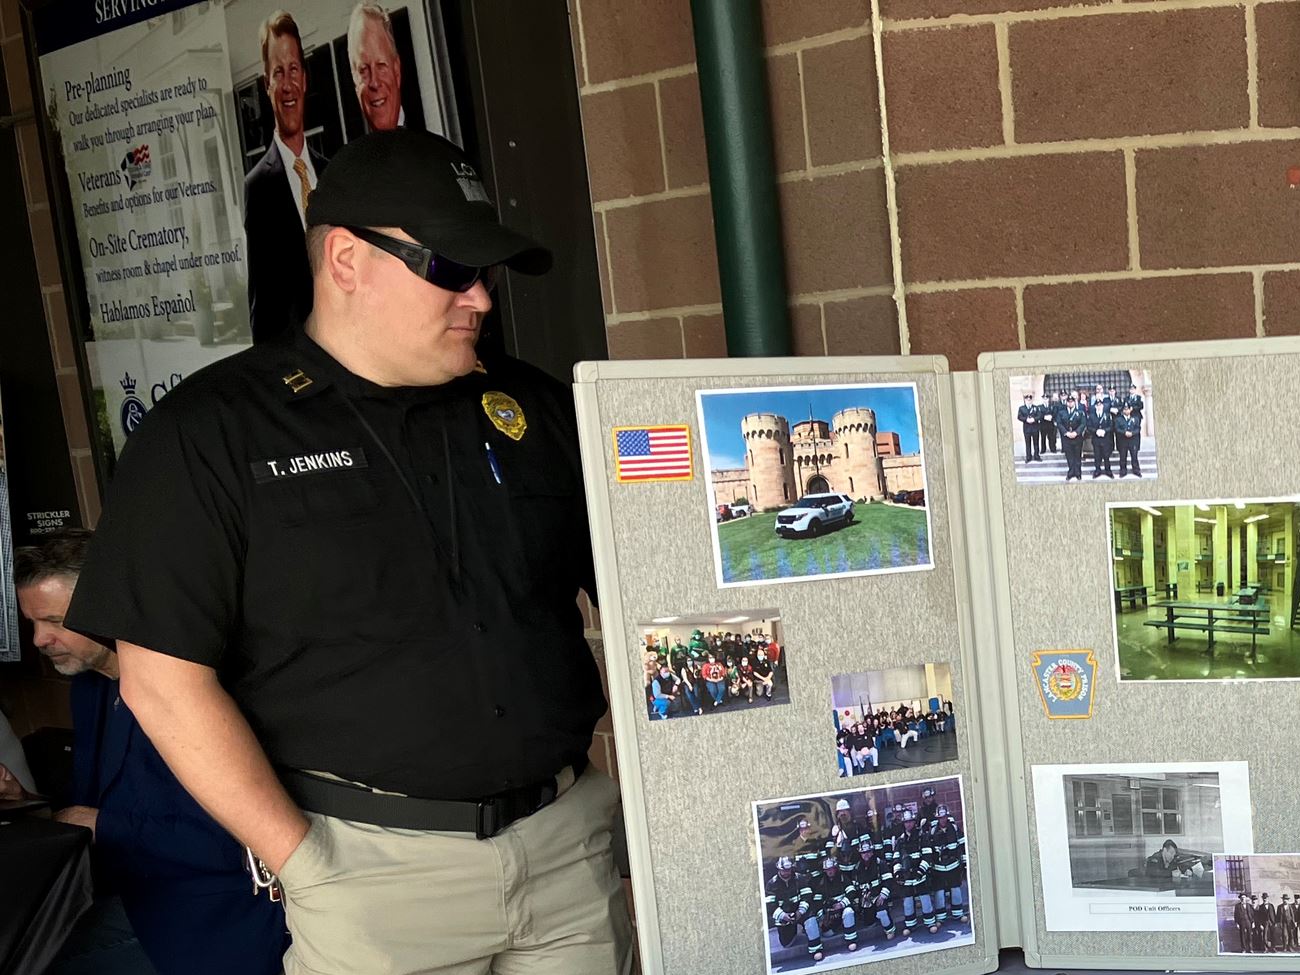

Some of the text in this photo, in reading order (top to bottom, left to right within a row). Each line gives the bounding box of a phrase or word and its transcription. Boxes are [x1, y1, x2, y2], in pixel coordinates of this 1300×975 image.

[64, 67, 132, 101] Pre-planning
[69, 77, 207, 126] Our dedicated specialists are ready to
[73, 103, 217, 153] walk you through arranging your plan.
[78, 169, 121, 193] Veterans
[83, 198, 110, 218] Benefits
[111, 195, 124, 212] and
[125, 191, 152, 213] options
[152, 186, 164, 203] for
[164, 187, 179, 200] our
[89, 226, 189, 258] On-Site Crematory,
[96, 244, 242, 283] witness room & chapel under one roof.
[100, 290, 196, 324] Hablamos Español
[267, 450, 353, 477] T. JENKINS
[27, 510, 71, 520] STRICKLER
[37, 518, 64, 528] SIGNS
